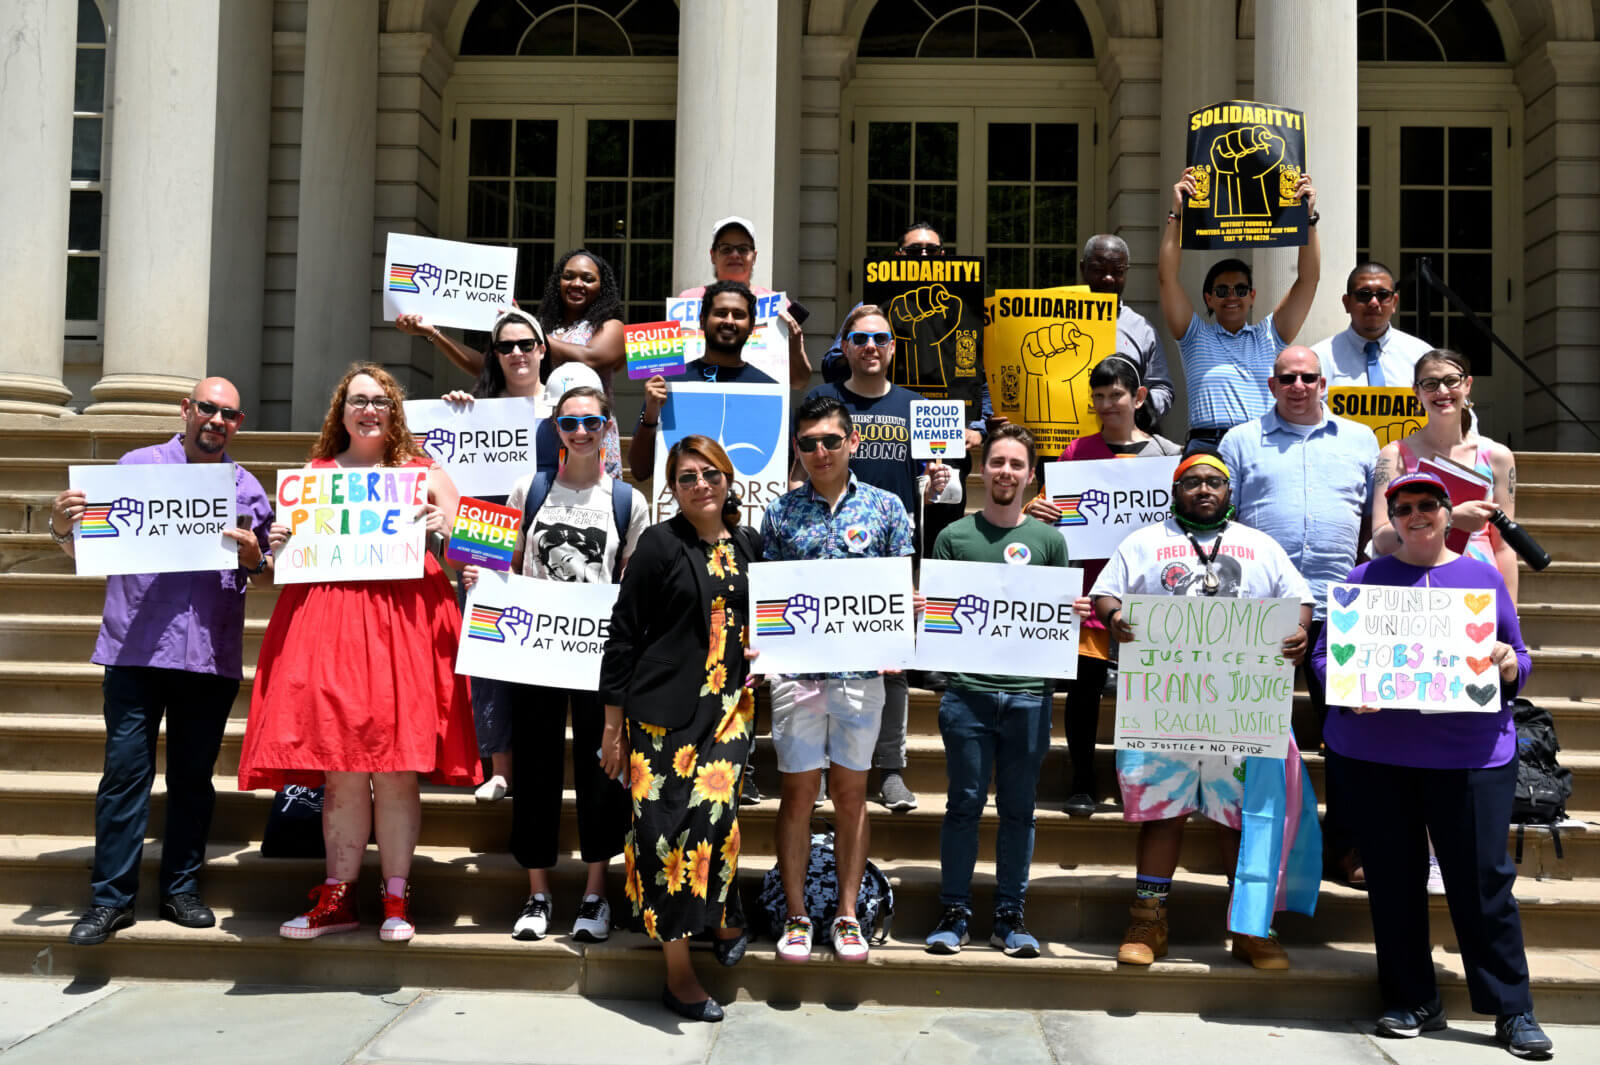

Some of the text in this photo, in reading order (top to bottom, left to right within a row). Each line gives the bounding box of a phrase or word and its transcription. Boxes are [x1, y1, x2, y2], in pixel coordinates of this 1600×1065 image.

[1191, 105, 1301, 131] SOLIDARITY!
[445, 269, 508, 291] PRIDE
[866, 260, 980, 283] SOLIDARITY!
[442, 288, 506, 304] AT WORK
[999, 297, 1113, 321] SOLIDARITY!
[626, 327, 680, 343] EQUITY
[627, 337, 683, 359] PRIDE
[916, 405, 959, 416] PROUD
[1332, 394, 1426, 417] SOLIDARI
[916, 417, 960, 428] EQUITY
[459, 428, 529, 449] PRIDE
[913, 429, 963, 440] MEMBER
[459, 450, 528, 464] AT WORK
[849, 442, 907, 461] RONG
[277, 471, 427, 507] CELEBRATE
[1114, 489, 1169, 509] PRID
[148, 498, 228, 519] PRIDE
[458, 504, 520, 530] EQUITY
[1114, 511, 1173, 524] AT WOR
[149, 522, 227, 536] AT WORK
[291, 509, 400, 536] PRIDE
[454, 518, 517, 548] PRIDE
[331, 544, 342, 568] A
[1156, 545, 1186, 562] FRED
[825, 594, 905, 617] PRIDE
[1366, 587, 1451, 612] FUND
[993, 599, 1073, 624] PRIDE
[535, 614, 611, 638] PRIDE
[825, 620, 905, 634] AT WORK
[991, 625, 1070, 641] AT WORK
[1129, 600, 1280, 646] ECONOMIC
[1365, 614, 1451, 638] UNION
[533, 638, 552, 650] AT
[1140, 649, 1285, 666] JUSTICE IS
[1356, 642, 1460, 669] JOBS for
[1120, 671, 1291, 703] TRANS JUSTICE
[1120, 708, 1288, 735] IS RACIAL JUSTICE
[1127, 741, 1264, 754] NO JUSTICE NO PRIDE
